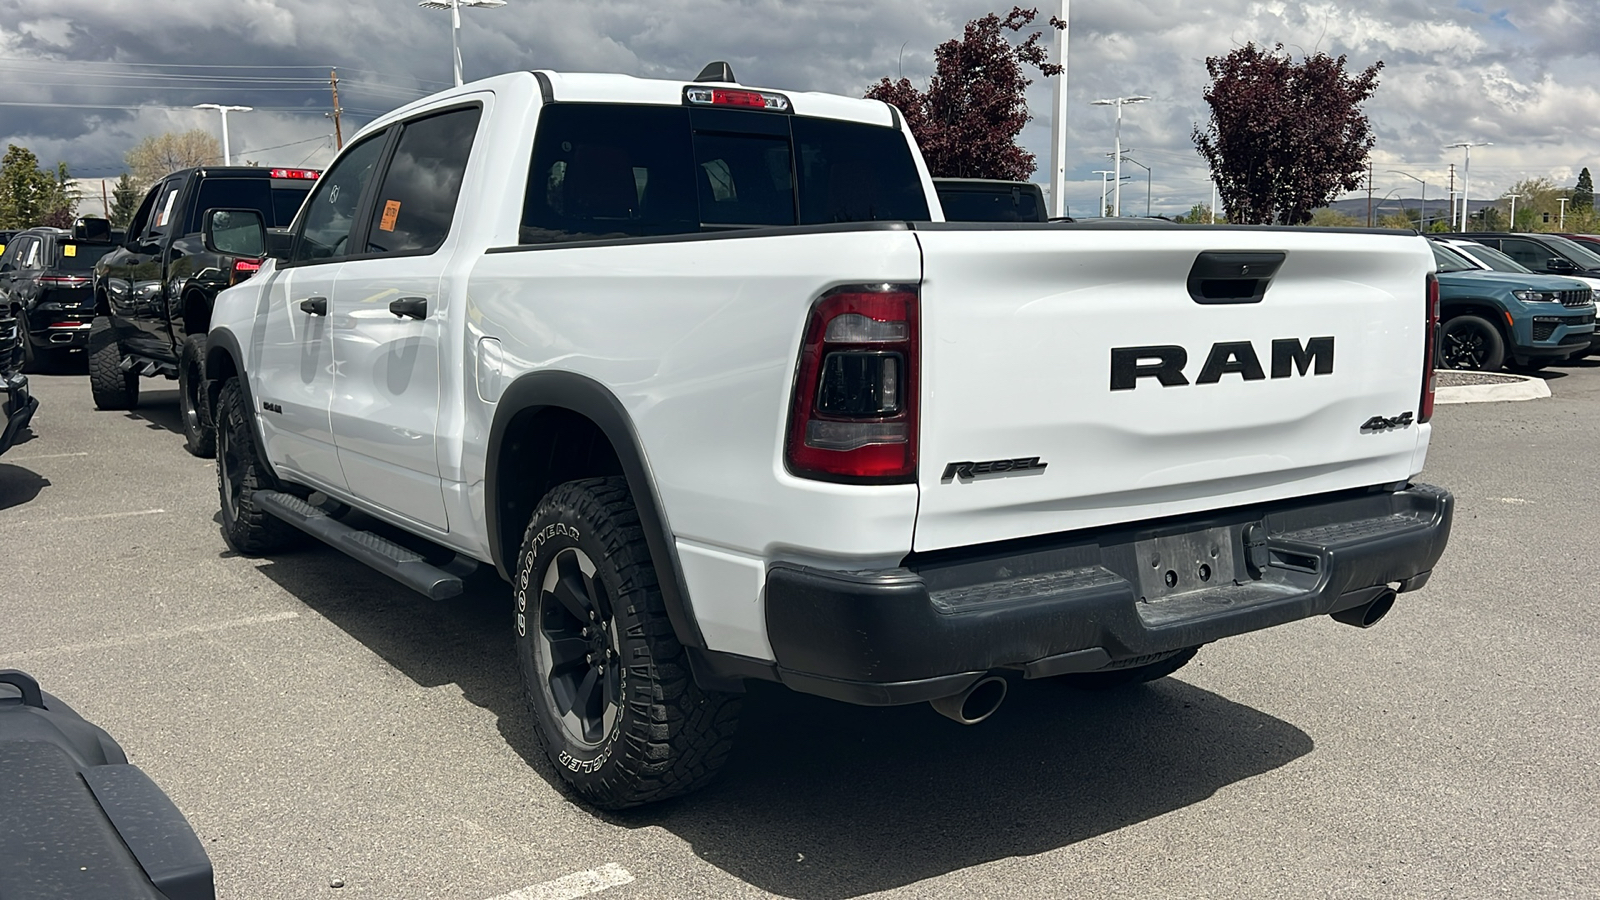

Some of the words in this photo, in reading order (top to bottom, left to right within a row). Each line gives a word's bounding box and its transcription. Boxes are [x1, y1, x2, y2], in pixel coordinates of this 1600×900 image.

[1110, 336, 1335, 391] RAM
[1360, 411, 1414, 430] 4x4
[941, 457, 1048, 479] REBEL
[517, 522, 580, 636] GOODYEAR
